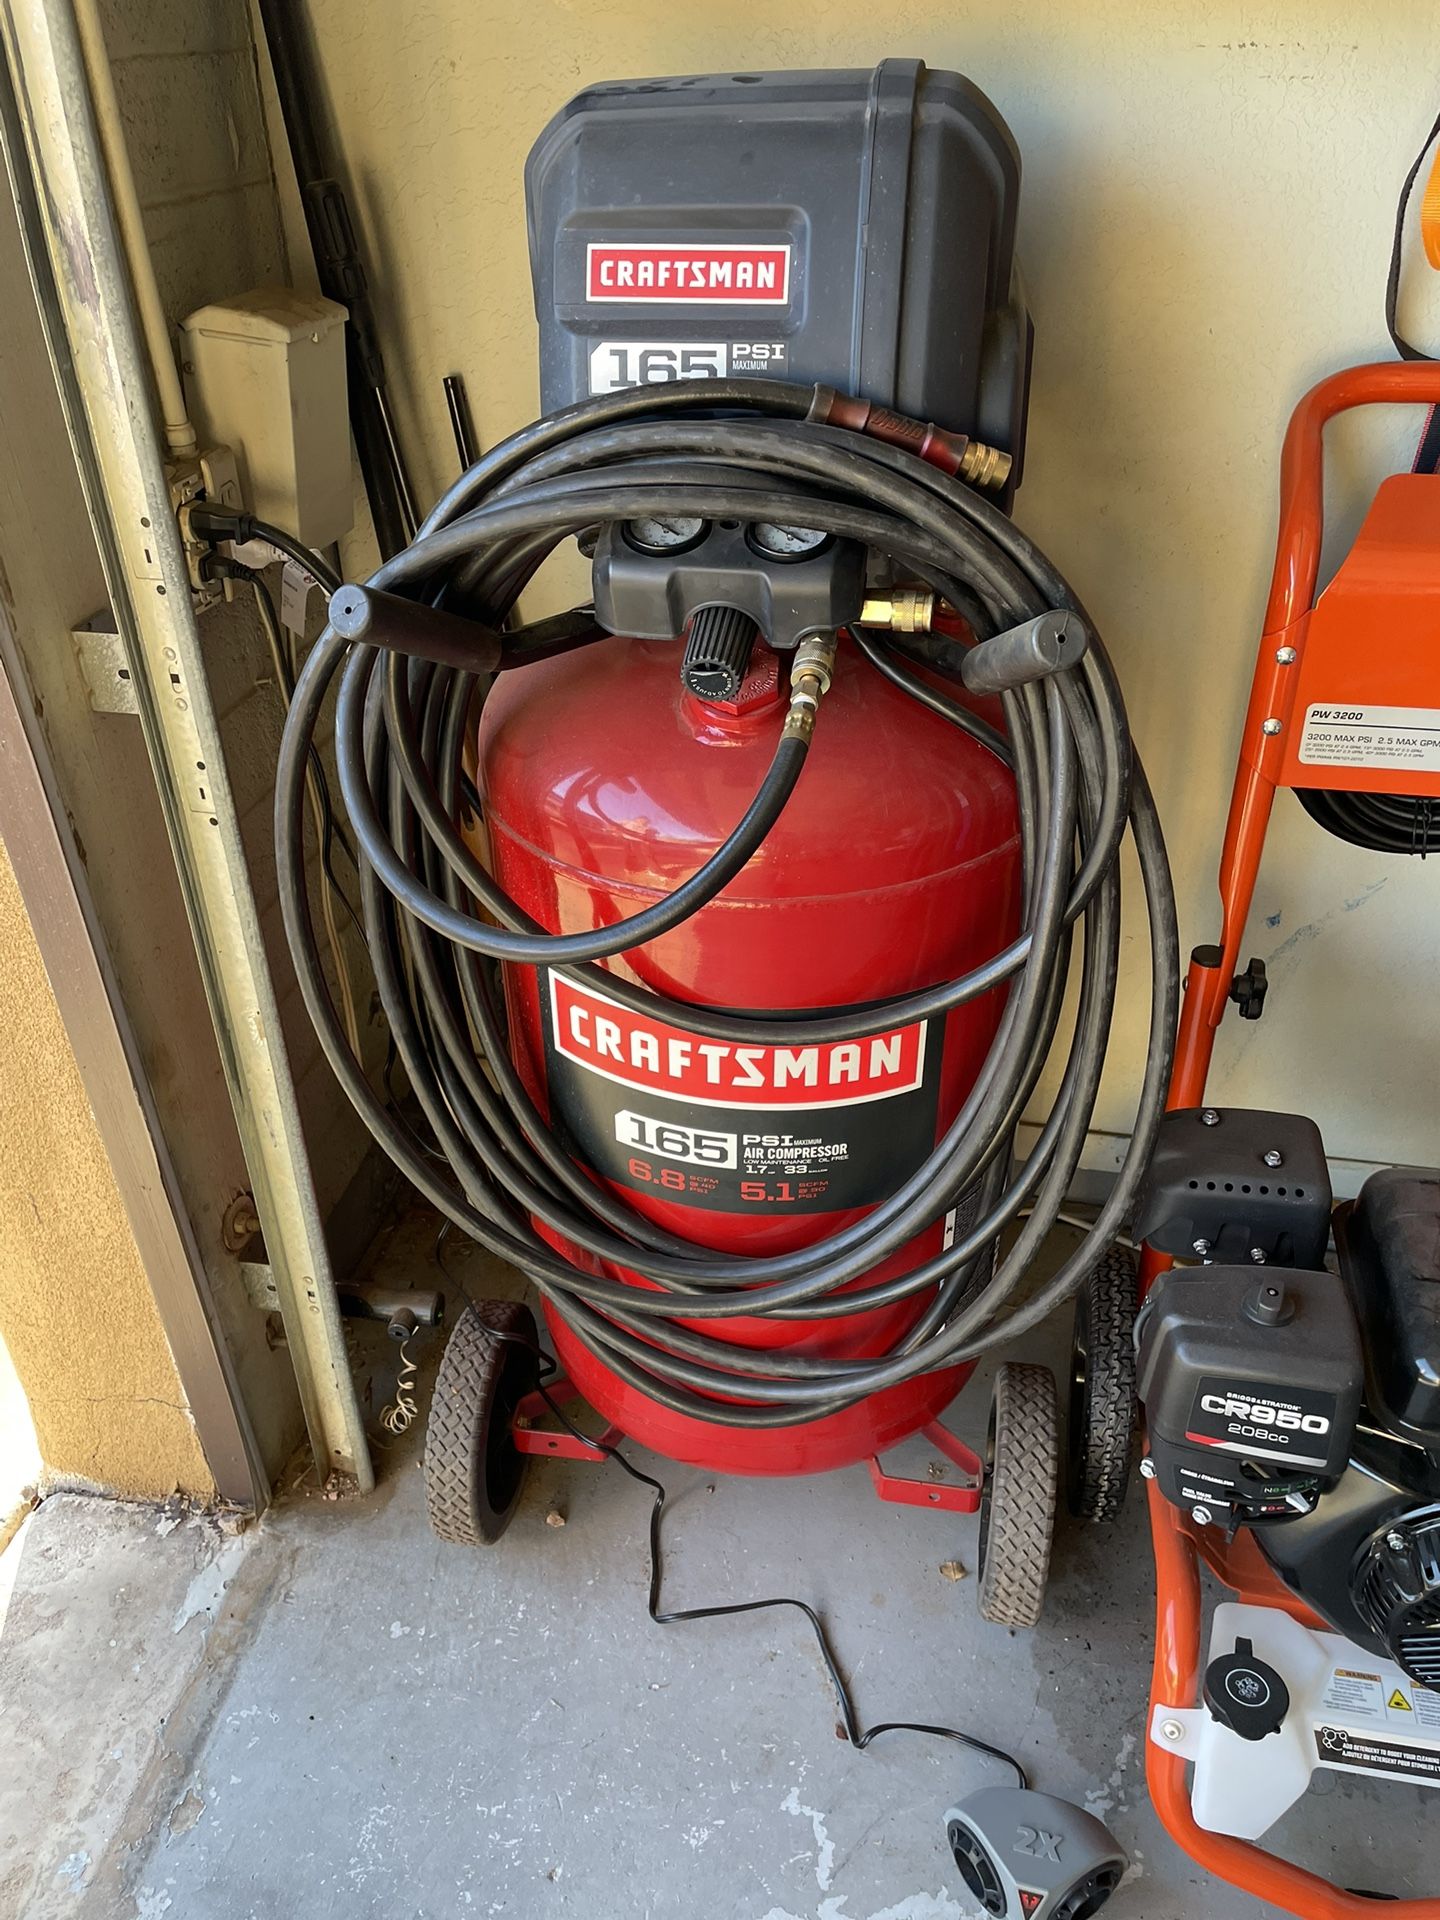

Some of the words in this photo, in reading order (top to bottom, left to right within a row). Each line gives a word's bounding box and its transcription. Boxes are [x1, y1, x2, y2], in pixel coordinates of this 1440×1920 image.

[600, 260, 776, 289] CRAFTSMAN
[609, 349, 718, 388] 165
[732, 343, 785, 360] PSI
[732, 360, 768, 370] MAXIMUM
[1311, 710, 1332, 719] PW
[1332, 711, 1364, 720] 3200
[1307, 733, 1332, 741] 3200
[1334, 734, 1355, 743] MAX
[1357, 735, 1372, 743] PSI
[1378, 737, 1393, 745] 2.5
[1395, 738, 1418, 746] MAX
[569, 1004, 902, 1088] CRAFTSMAN
[630, 1116, 729, 1164] 165
[742, 1134, 794, 1147] PSI
[743, 1147, 764, 1159] AIR
[767, 1143, 848, 1160] COMPRESSOR
[831, 1154, 849, 1162] FREE
[628, 1158, 686, 1191] 6.8
[784, 1165, 808, 1175] 33
[740, 1181, 795, 1202] 5.1
[1200, 1394, 1330, 1435] CR950
[1227, 1423, 1289, 1444] 208cc
[1012, 1825, 1064, 1864] 2X
